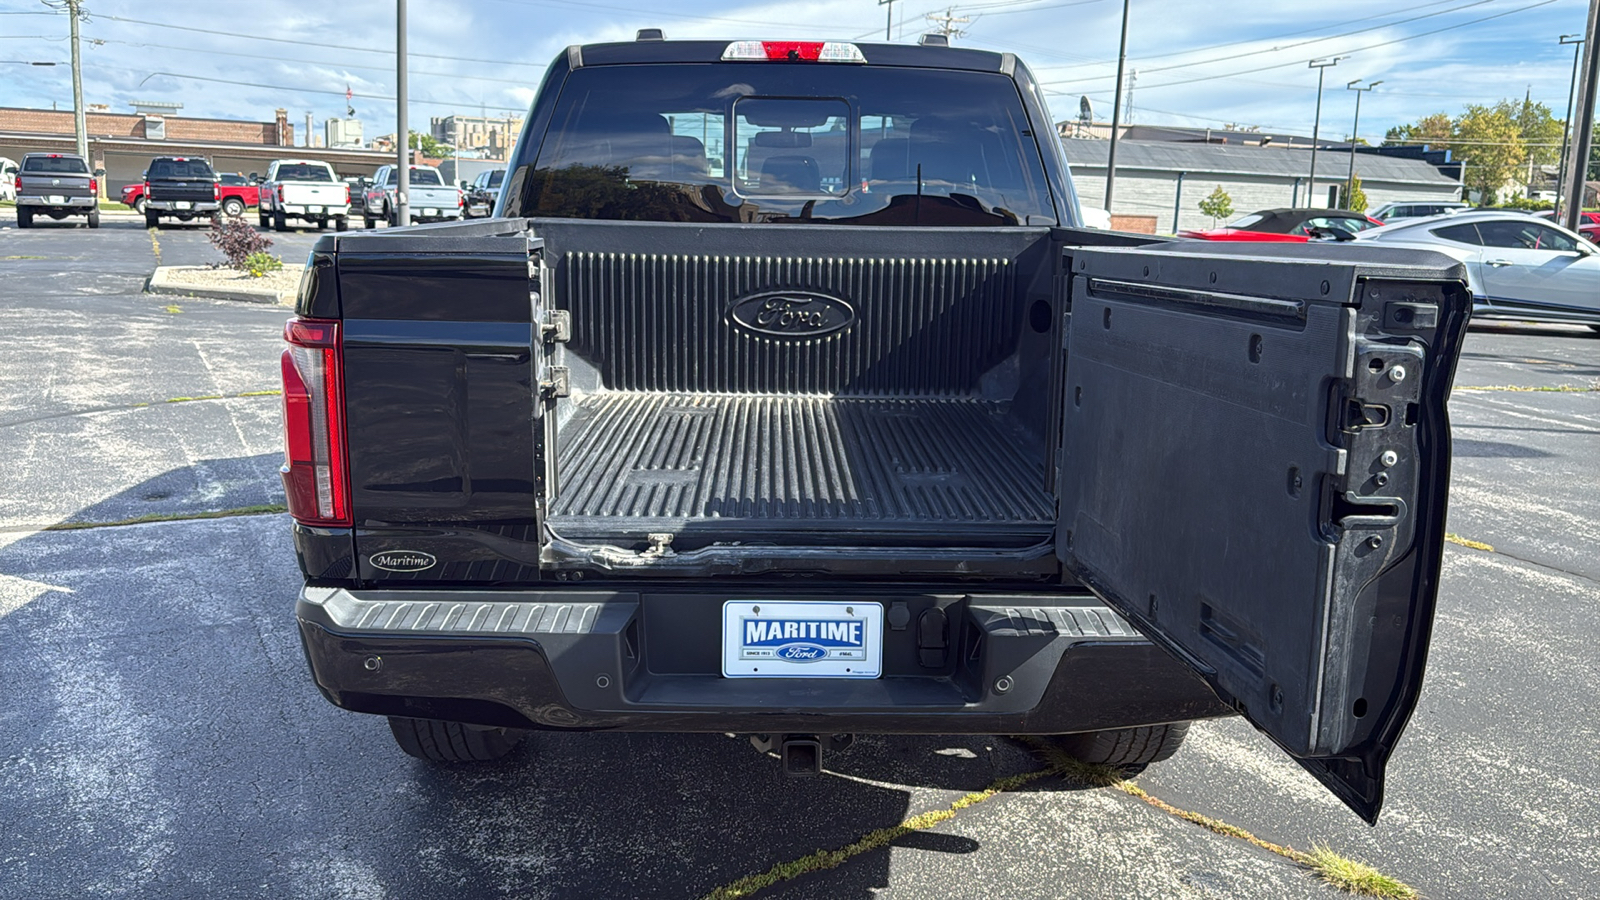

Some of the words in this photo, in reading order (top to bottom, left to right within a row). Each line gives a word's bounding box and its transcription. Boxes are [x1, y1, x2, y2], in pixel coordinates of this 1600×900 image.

[758, 296, 830, 329] Ford
[377, 555, 429, 566] Maritime
[746, 621, 861, 645] MARITIME
[785, 647, 817, 659] Ford
